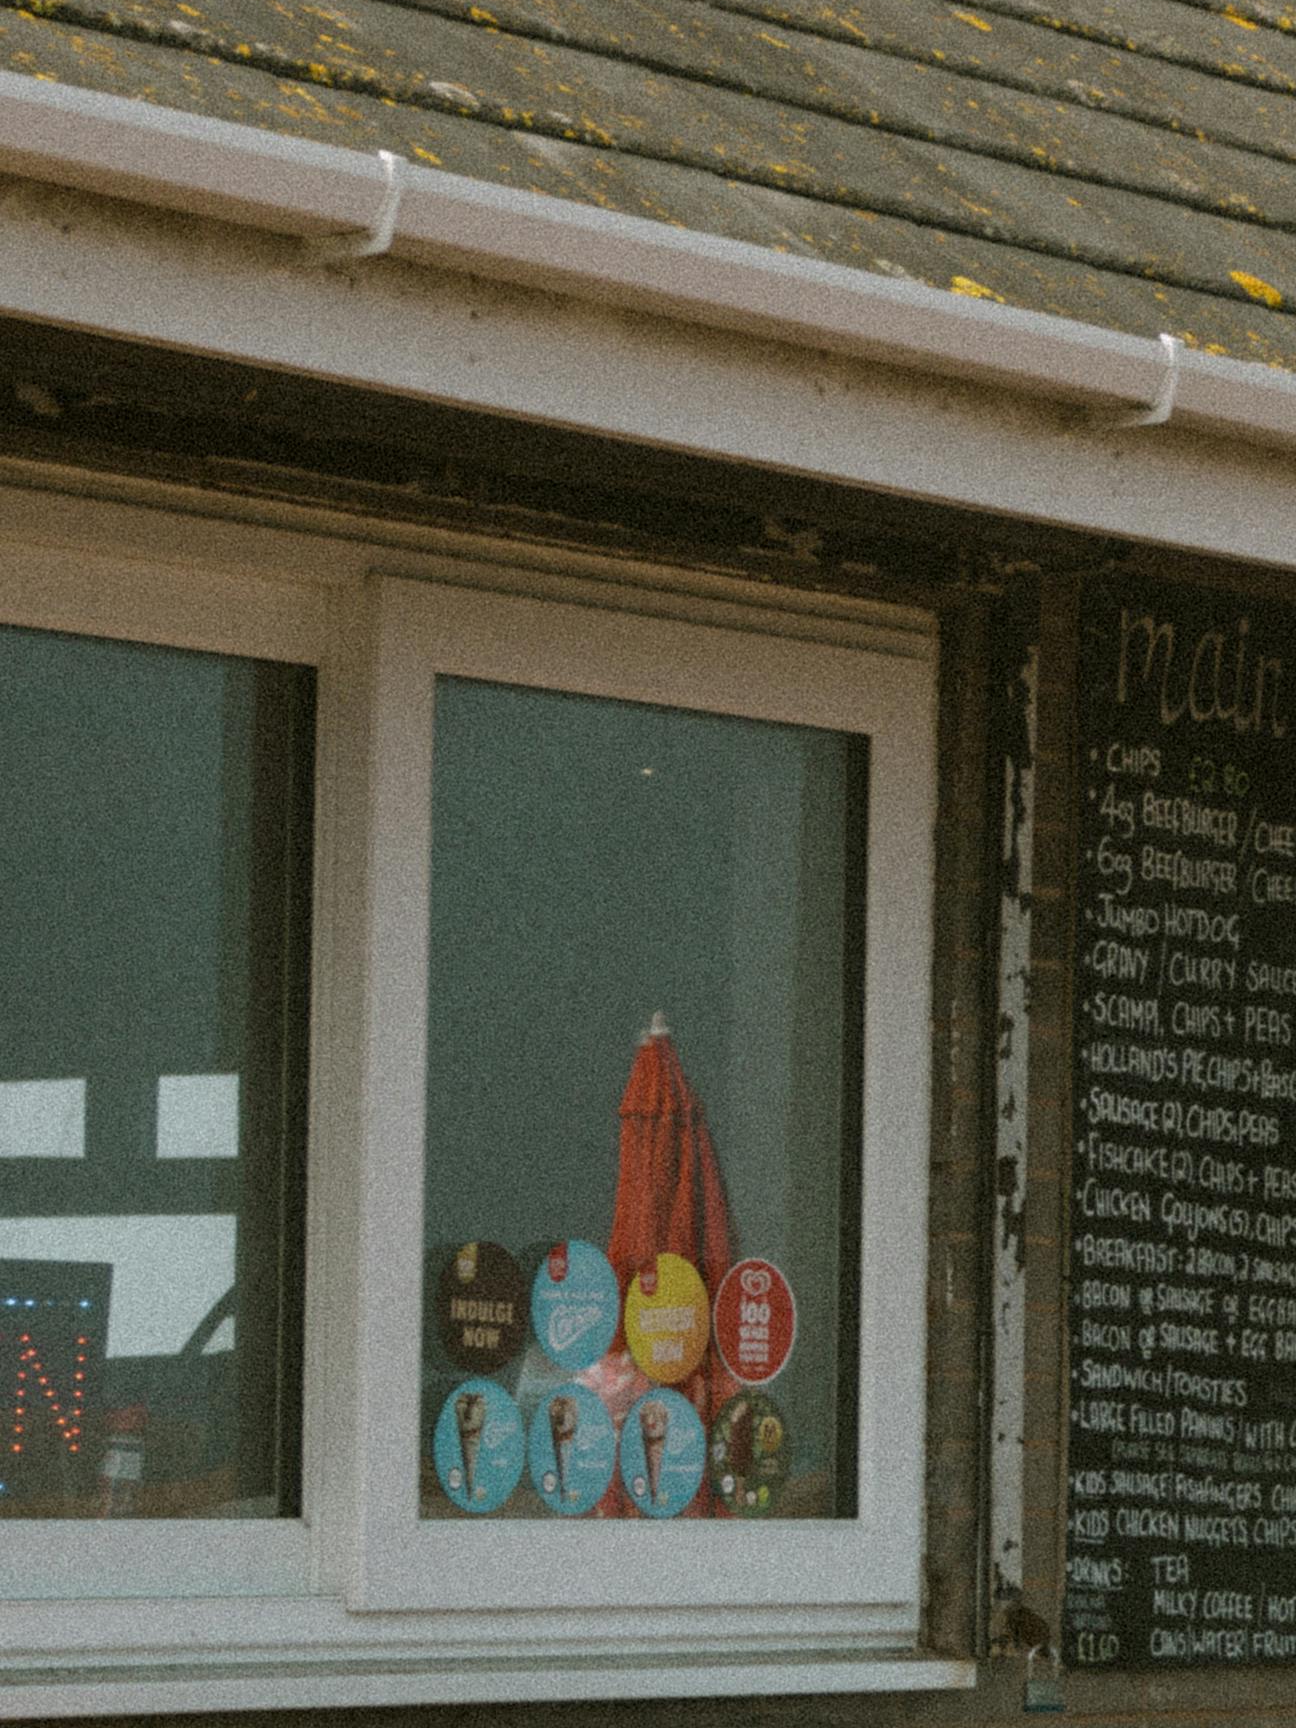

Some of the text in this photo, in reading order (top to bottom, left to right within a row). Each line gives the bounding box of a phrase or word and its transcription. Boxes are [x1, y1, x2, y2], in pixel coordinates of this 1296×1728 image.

[1106, 742, 1162, 778] CHIPS
[1098, 892, 1160, 938] JUMBO
[1092, 939, 1150, 985] GRAVY
[1168, 951, 1238, 991] CURRY
[1171, 1000, 1222, 1038] CHIPS
[1244, 1005, 1293, 1046] PEAS
[1199, 1154, 1244, 1194] CHIPS
[1081, 1176, 1152, 1223] CHICKEN
[1081, 1279, 1132, 1311] BACON
[1156, 1282, 1215, 1315] SAUSAGE
[1081, 1318, 1132, 1353] BACON
[1158, 1322, 1219, 1356] SAUSAGE
[1079, 1401, 1127, 1433] LARGE
[1129, 1403, 1175, 1437] FILLED
[1074, 1471, 1107, 1499] KIDS
[1074, 1508, 1109, 1538] KIDS
[1116, 1507, 1179, 1540] CHICKEN
[1150, 1554, 1190, 1584] TEA
[1152, 1588, 1198, 1620] MILKY
[1203, 1591, 1253, 1621] COFFEE
